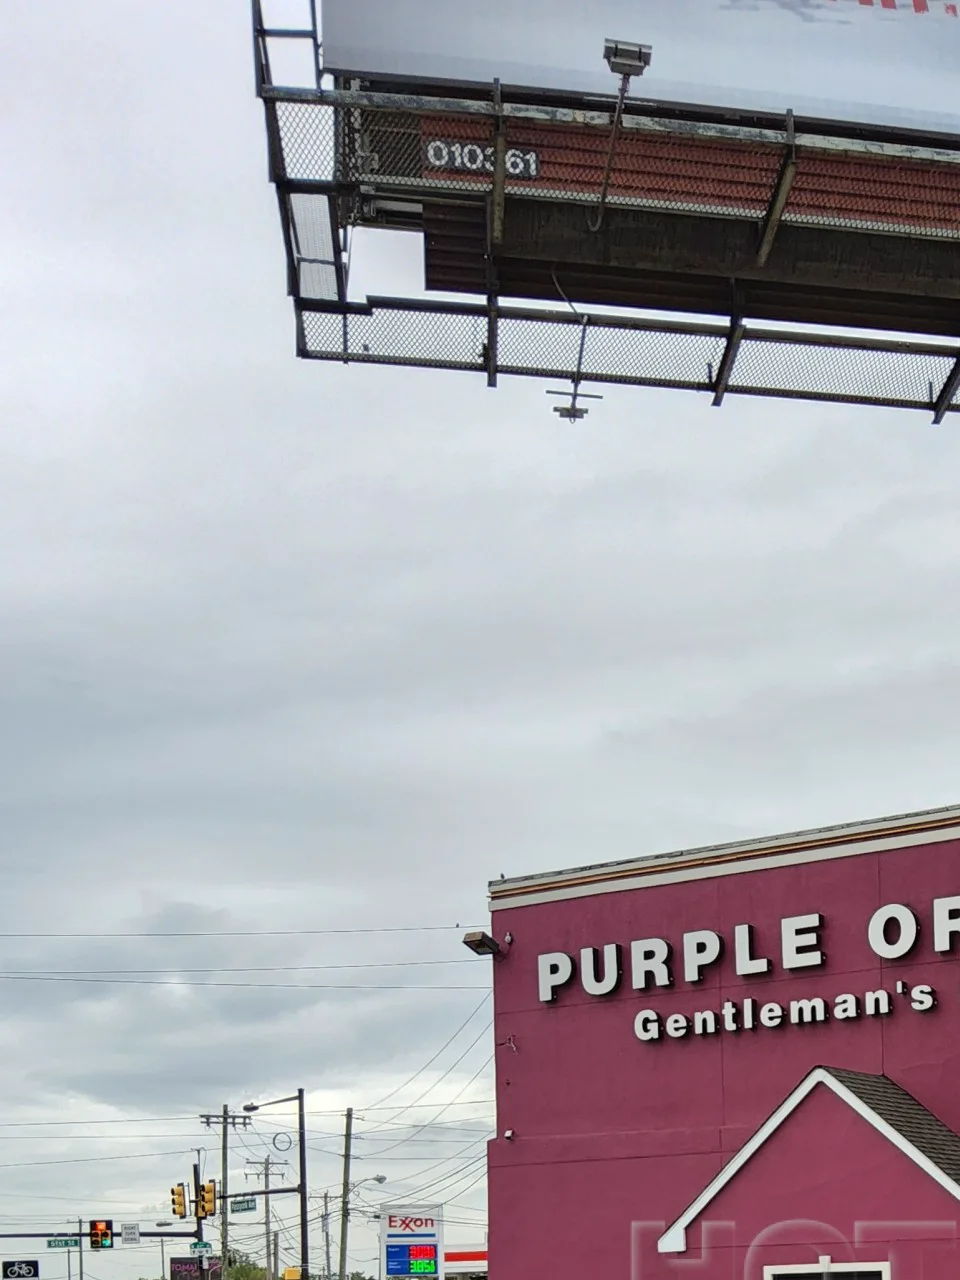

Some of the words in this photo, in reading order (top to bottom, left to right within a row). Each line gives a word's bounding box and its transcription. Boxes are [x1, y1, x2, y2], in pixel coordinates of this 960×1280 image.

[537, 912, 824, 1003] PURPLE
[633, 981, 934, 1041] Gentleman's
[388, 1215, 434, 1232] Exxon
